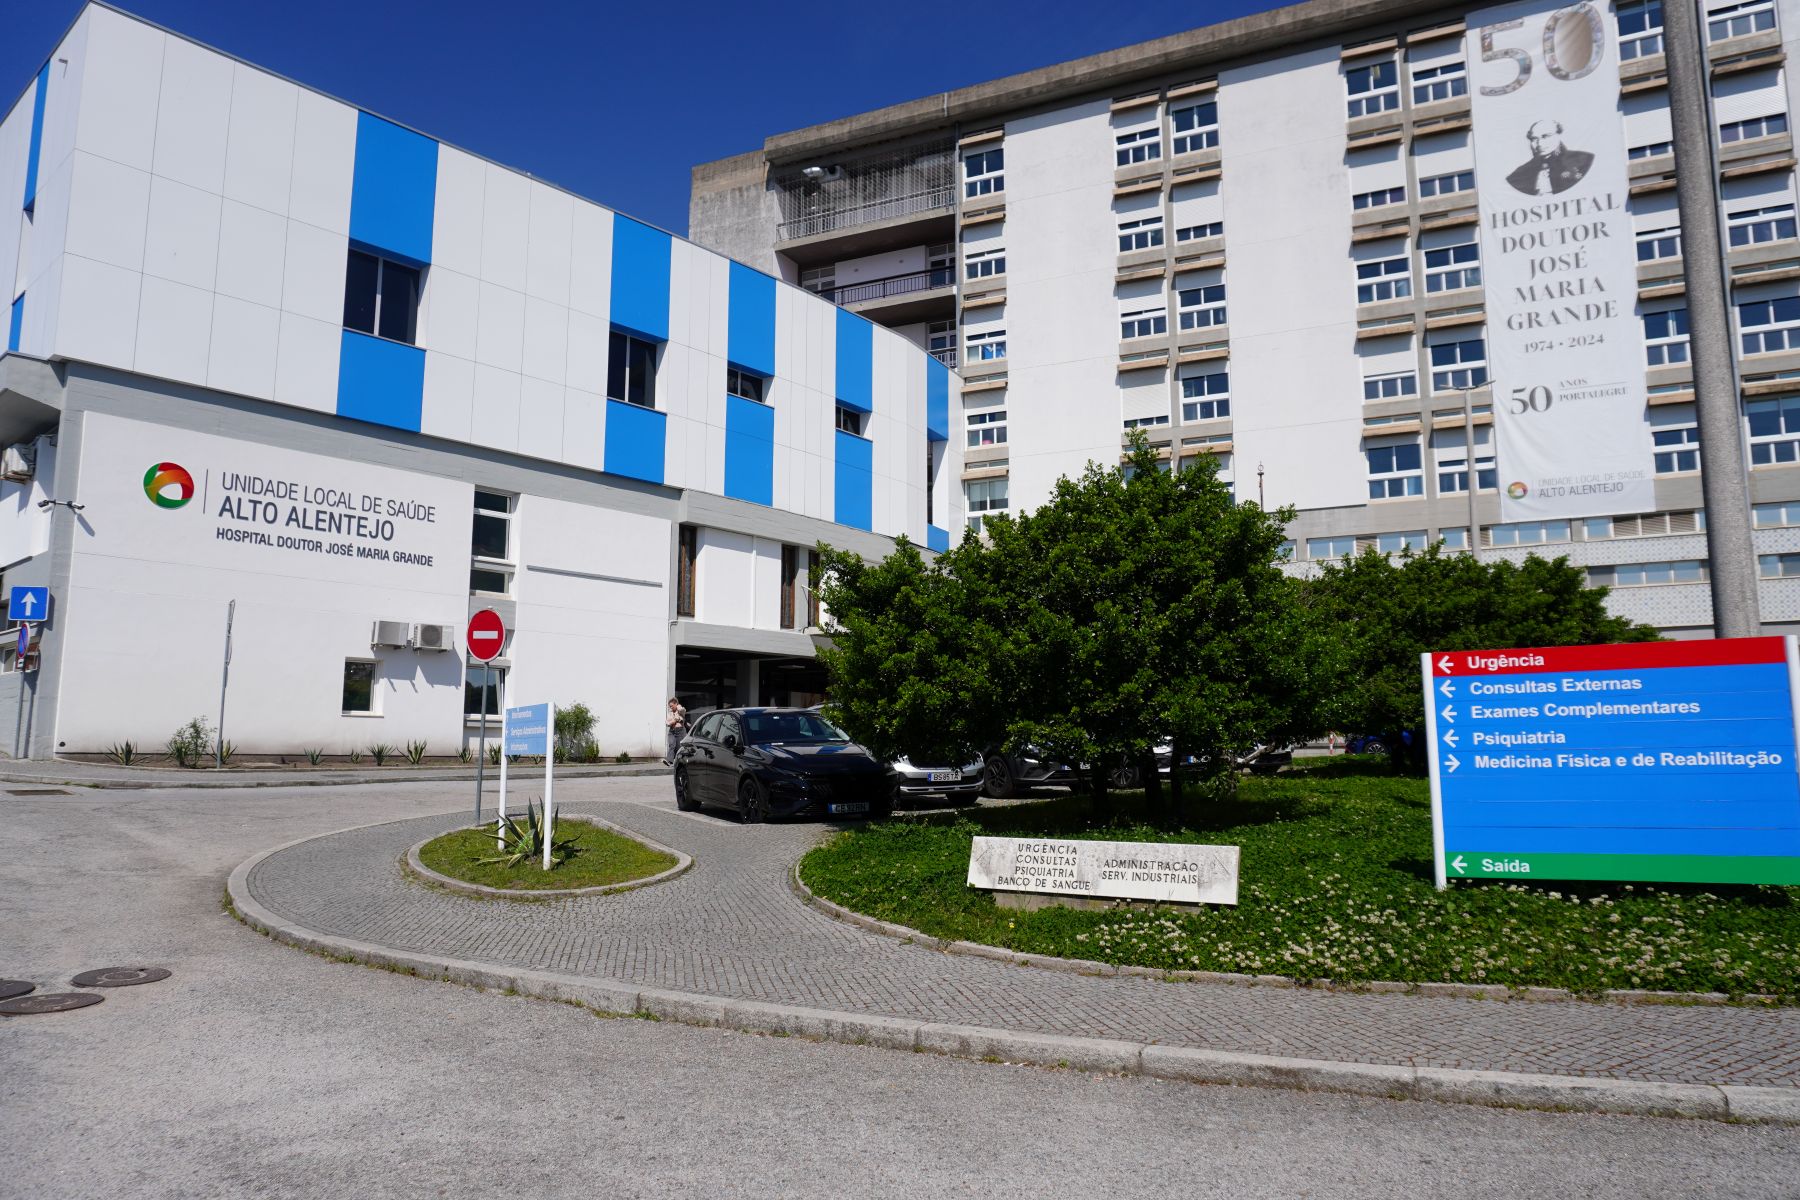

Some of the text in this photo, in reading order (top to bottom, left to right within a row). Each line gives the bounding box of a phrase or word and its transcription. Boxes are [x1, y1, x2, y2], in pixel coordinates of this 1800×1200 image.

[1480, 3, 1605, 96] 50
[1492, 193, 1620, 229] HOSPITAL
[1502, 221, 1611, 253] DOUTOR
[1530, 245, 1588, 280] JOSÉ
[1515, 276, 1605, 304] MARIA
[1507, 300, 1619, 331] GRANDE
[1524, 333, 1605, 353] 1974 2024
[1559, 378, 1588, 389] ANOS
[1510, 385, 1553, 415] 50
[1559, 386, 1629, 402] PORTALEGRE
[1538, 470, 1646, 487] UNIDADE LOCAL DE SAÚDE
[222, 471, 436, 523] UNIDADE LOCAL DE SAÚDE
[1539, 482, 1624, 498] ALTO ALENTEJO
[218, 495, 394, 541] ALTO ALENTEJO
[216, 527, 434, 567] HOSPITAL DOUTOR JOSÉ MARIA GRANDE
[1467, 653, 1545, 671] Urgência
[1469, 677, 1643, 695] Consultas Externas
[1471, 700, 1701, 719] Exames Complementares
[1472, 731, 1567, 747] Psiquiatria
[1474, 751, 1783, 769] Medicina Física e de Reabilitação
[1018, 843, 1078, 855] URGÊNCIA
[1016, 854, 1077, 866] CONSULTAS
[1481, 858, 1531, 873] Saída
[1014, 866, 1075, 878] PSIQUIATRIA
[1101, 870, 1198, 885] SERV. INDUSTRIAIS
[997, 876, 1091, 891] BANCO DE SANGUE
